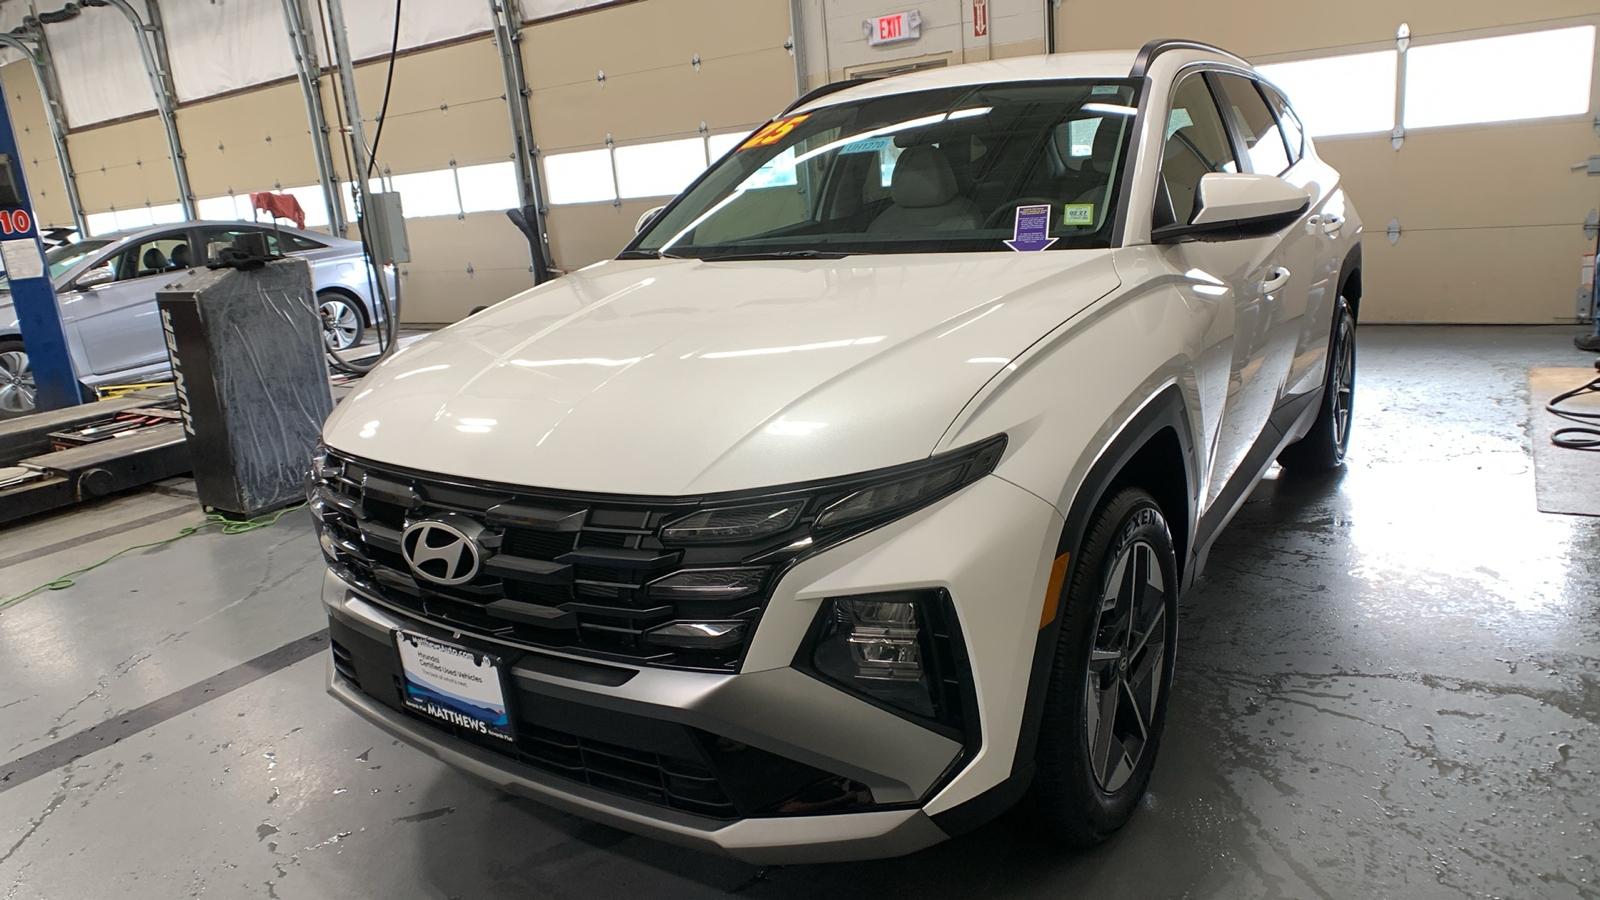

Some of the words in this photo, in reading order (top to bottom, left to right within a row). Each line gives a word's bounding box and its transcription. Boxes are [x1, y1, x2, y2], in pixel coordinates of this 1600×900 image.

[879, 15, 902, 40] EXIT
[739, 114, 811, 150] 25
[0, 209, 31, 234] 10
[161, 308, 196, 436] HUNTER
[417, 650, 440, 664] Hyundai
[419, 658, 442, 672] Certified
[457, 670, 483, 684] Vehicles
[427, 703, 487, 734] MATTHEWS
